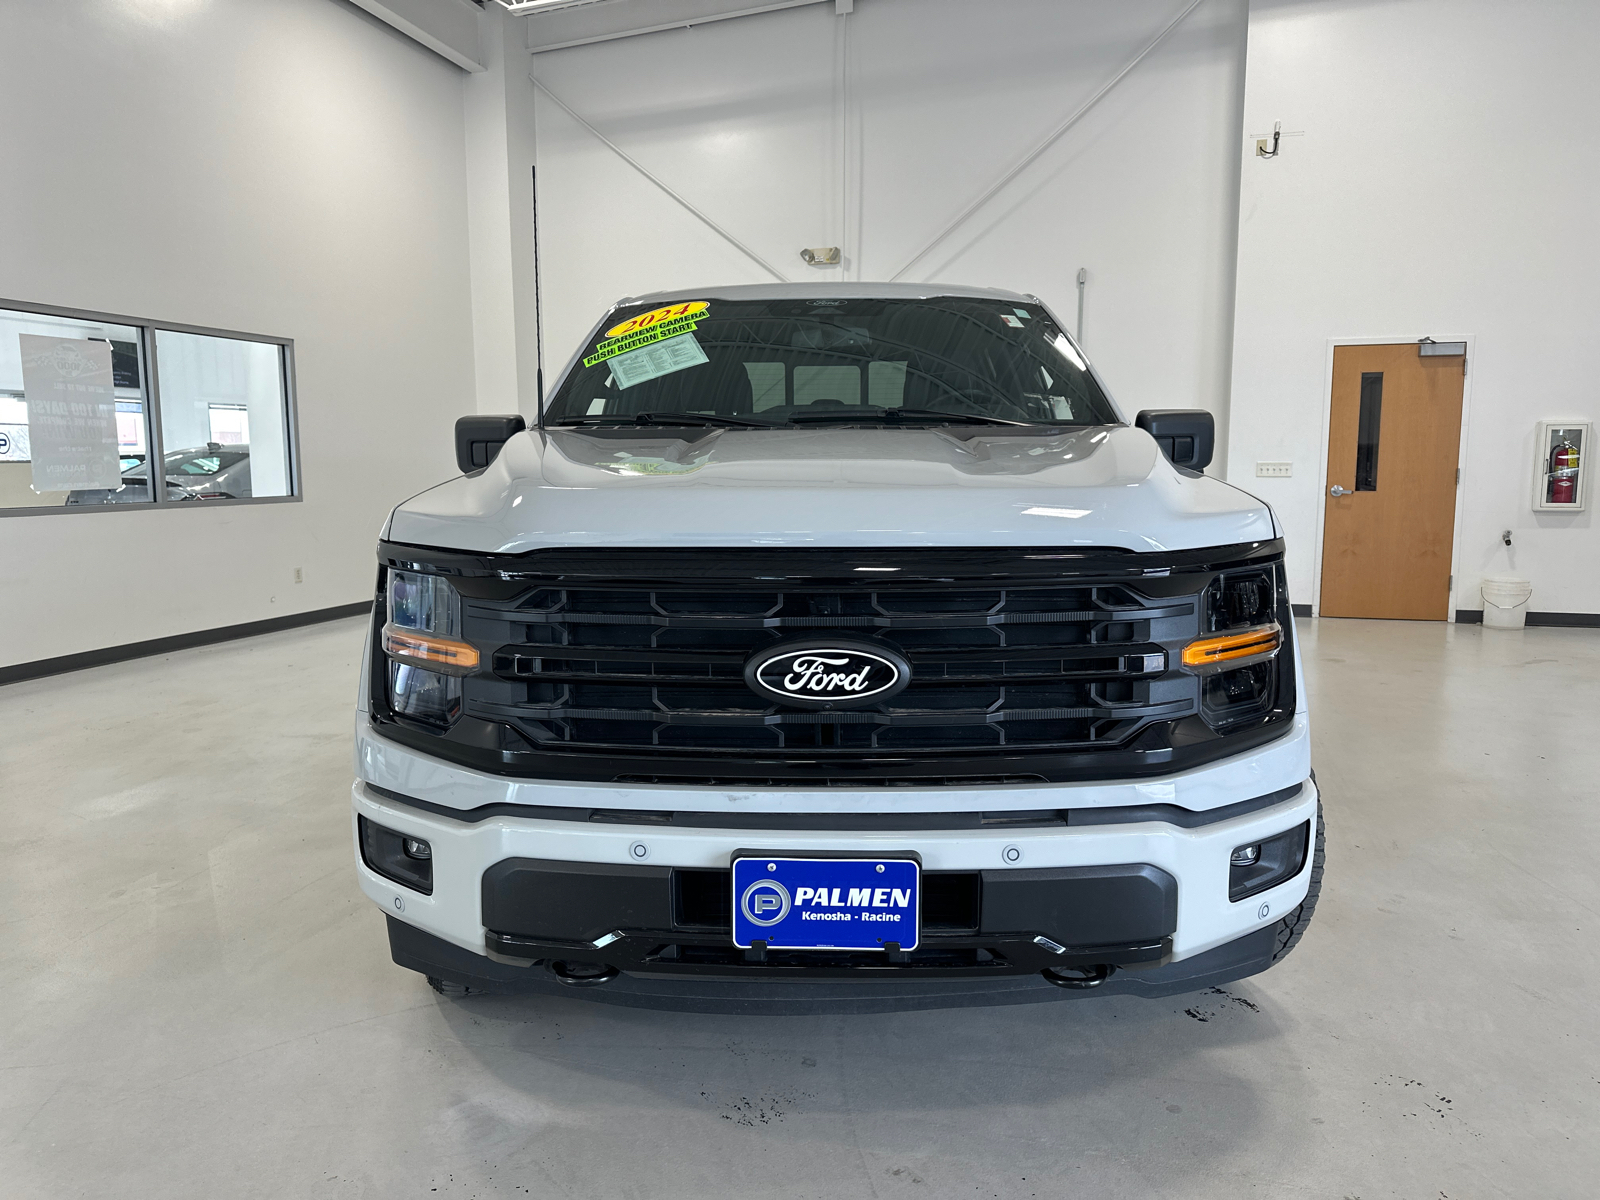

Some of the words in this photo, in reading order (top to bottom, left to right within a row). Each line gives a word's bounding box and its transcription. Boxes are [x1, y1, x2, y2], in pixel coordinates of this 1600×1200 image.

[598, 324, 658, 350] REARVIEW
[658, 310, 707, 329] CAMERA
[620, 303, 691, 334] 2024
[586, 346, 616, 365] PUSH
[617, 333, 659, 352] BUTTON
[660, 322, 691, 338] START
[784, 656, 871, 691] Ford
[794, 887, 912, 908] PALMEN
[802, 911, 852, 921] Kenosha
[862, 912, 901, 922] Racine
